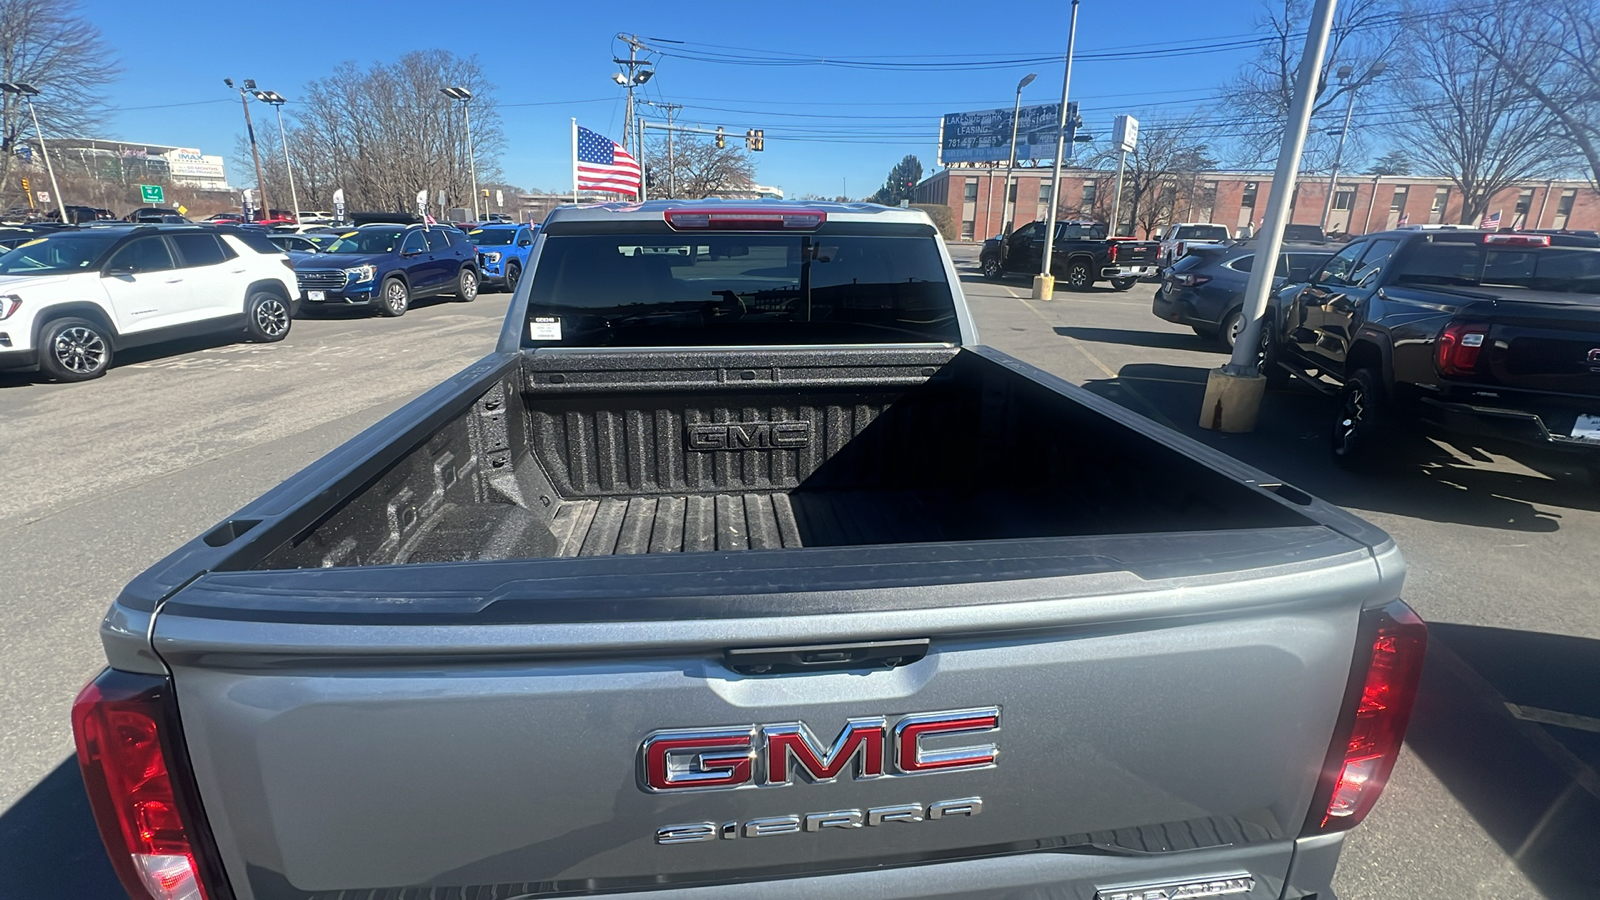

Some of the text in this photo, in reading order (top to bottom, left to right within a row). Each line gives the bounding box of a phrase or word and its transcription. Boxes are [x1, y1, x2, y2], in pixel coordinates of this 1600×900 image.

[946, 114, 981, 125] LAKESIDE
[957, 125, 989, 136] LEASING
[178, 153, 204, 161] IMAX
[689, 423, 808, 448] GMC
[643, 705, 1001, 792] GMC
[655, 796, 983, 845] SIERRA
